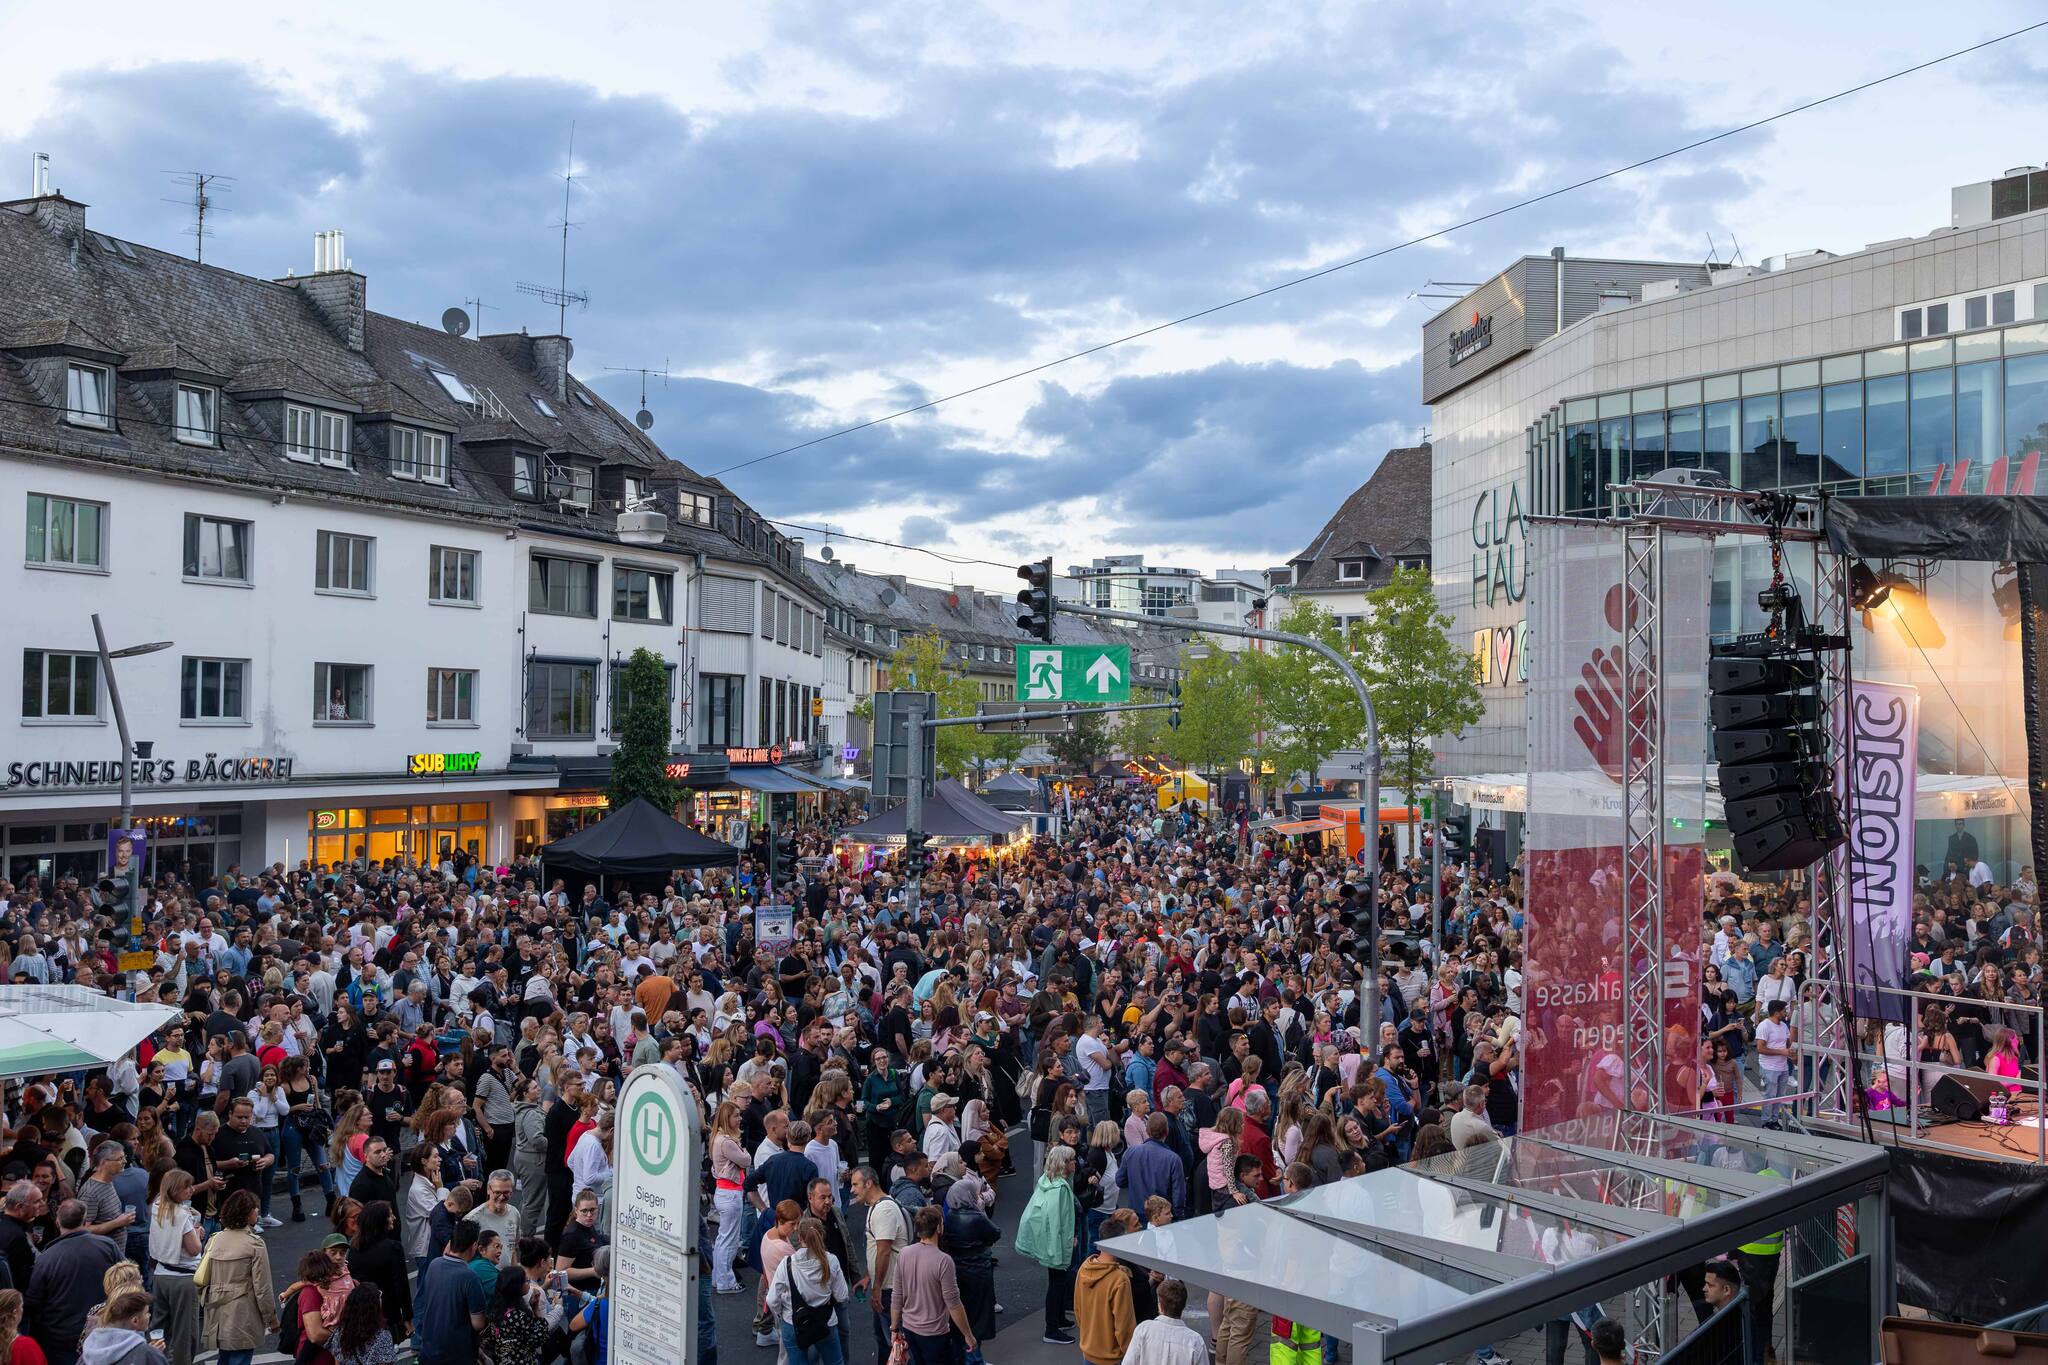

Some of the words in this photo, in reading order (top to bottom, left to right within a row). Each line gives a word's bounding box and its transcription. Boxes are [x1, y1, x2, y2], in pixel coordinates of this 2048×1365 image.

[1449, 315, 1492, 355] Schneider
[1473, 481, 1527, 549] GLA
[1473, 540, 1527, 610] HAU
[411, 752, 481, 774] SUBWAY
[748, 749, 752, 762] &
[753, 749, 769, 762] MORE
[185, 752, 293, 782] BÄCKEREI
[1850, 694, 1907, 907] NOISIC
[636, 1186, 666, 1208] Siegen
[629, 1204, 656, 1225] Kölner
[659, 1215, 672, 1232] Tor
[622, 1235, 636, 1250] R10
[622, 1259, 636, 1274] R16
[621, 1284, 635, 1298] R27
[621, 1309, 633, 1323] R51
